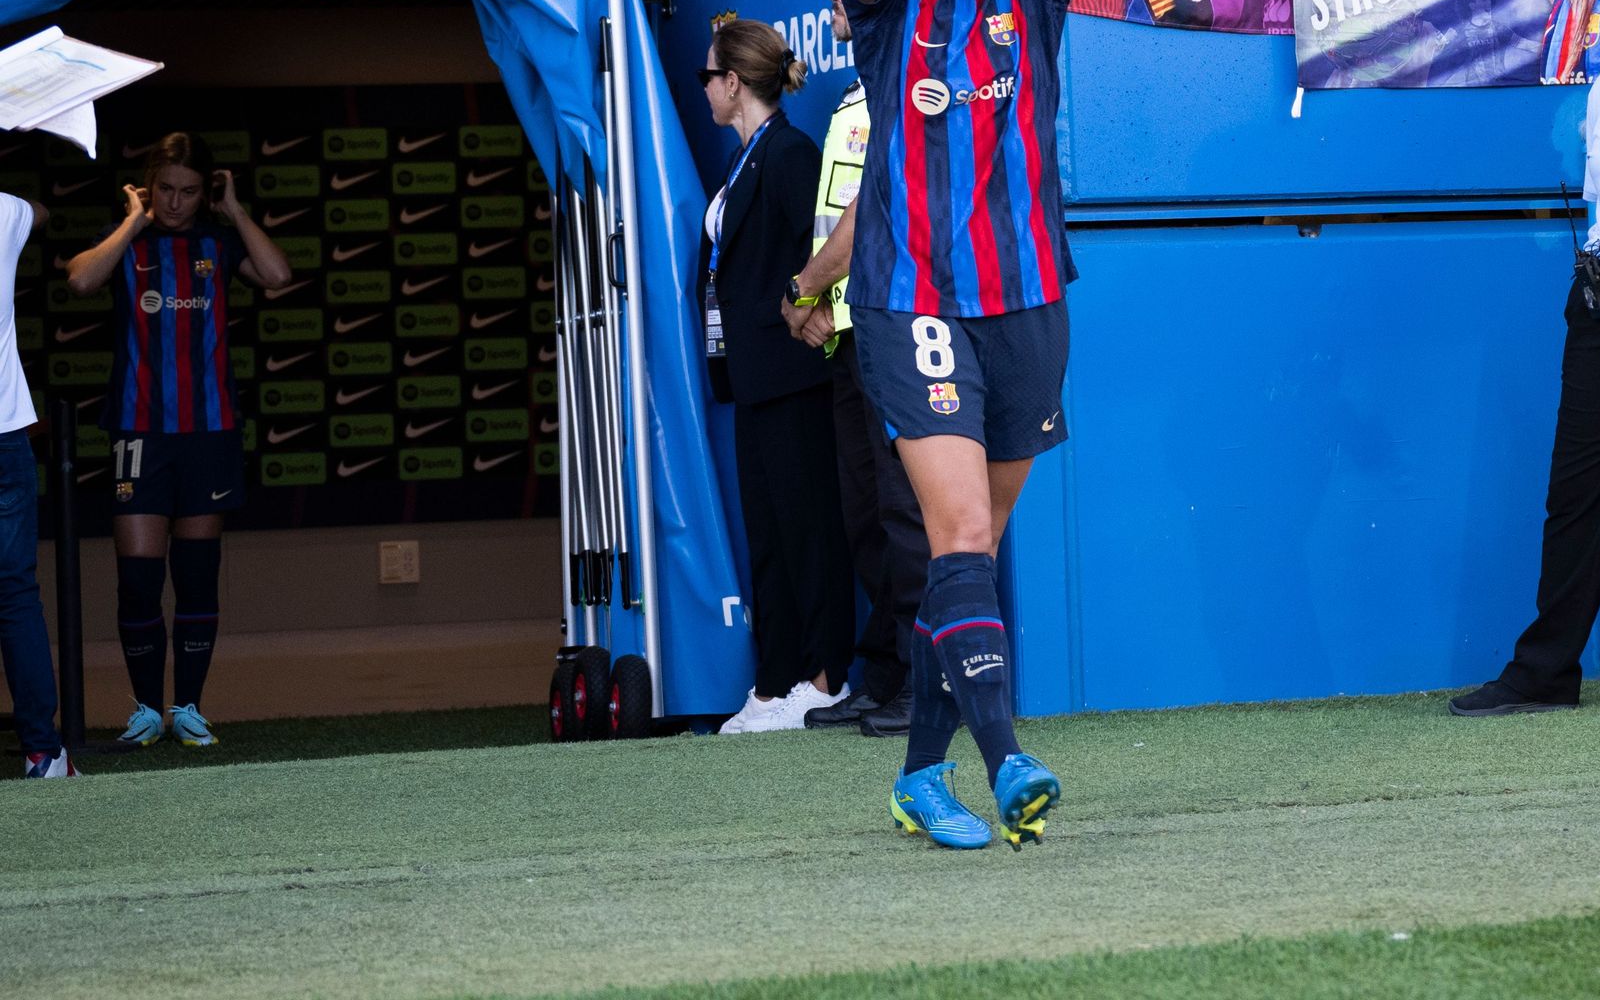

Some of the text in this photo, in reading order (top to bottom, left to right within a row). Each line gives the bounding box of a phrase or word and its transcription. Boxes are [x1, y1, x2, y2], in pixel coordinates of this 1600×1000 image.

[955, 76, 1016, 105] Spotif
[166, 295, 210, 310] Spotify
[911, 316, 955, 378] 8
[113, 438, 143, 479] 11
